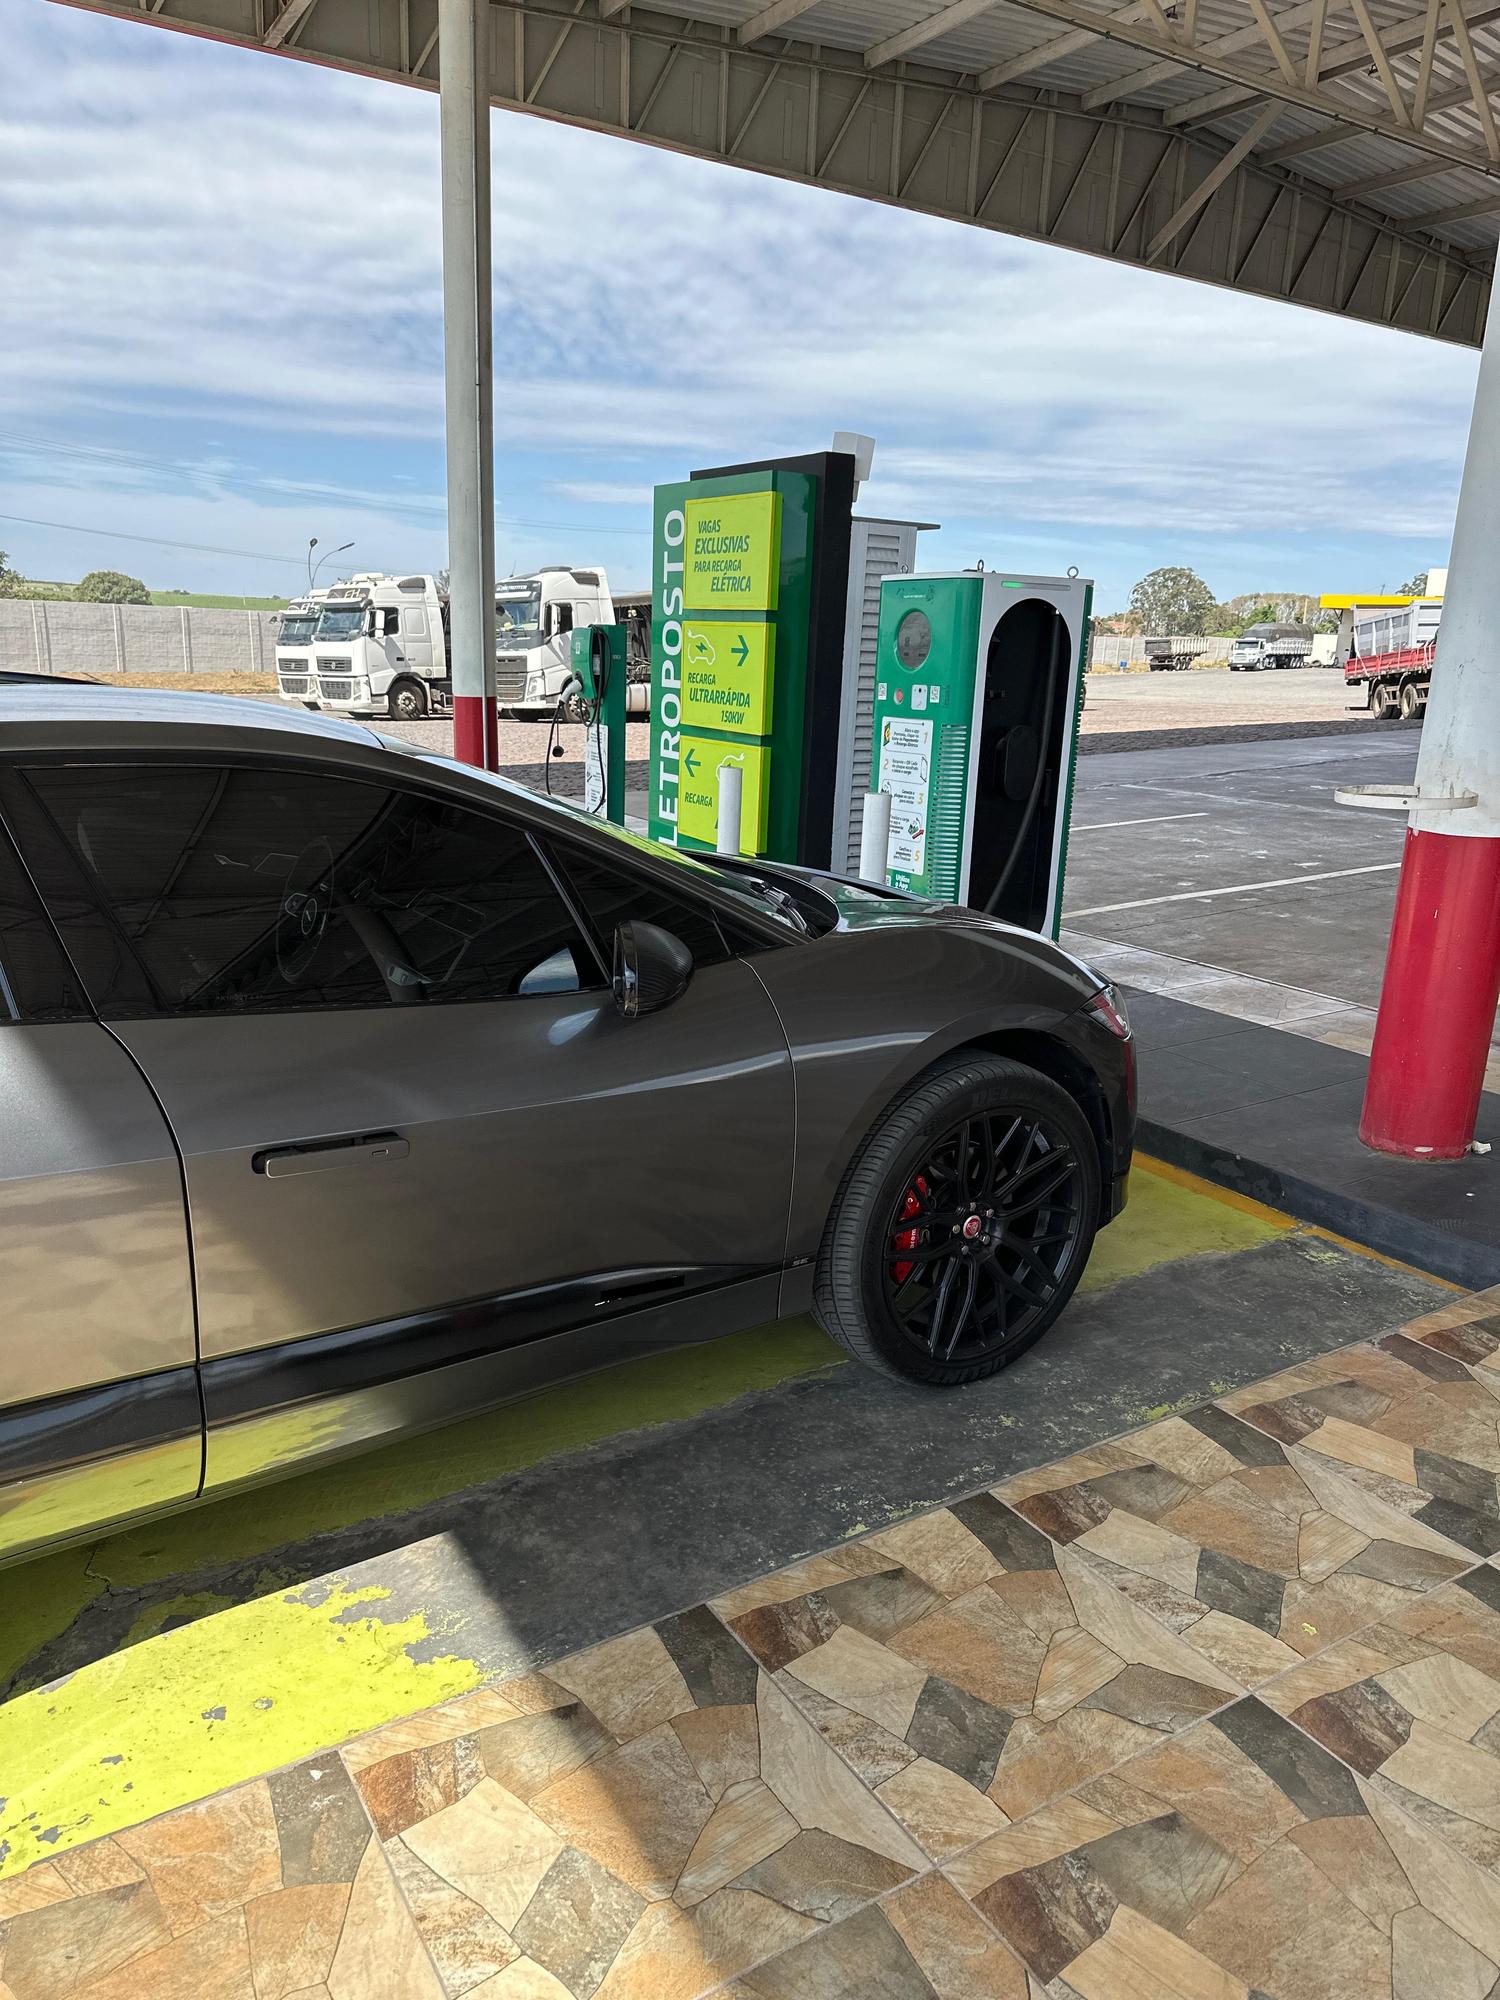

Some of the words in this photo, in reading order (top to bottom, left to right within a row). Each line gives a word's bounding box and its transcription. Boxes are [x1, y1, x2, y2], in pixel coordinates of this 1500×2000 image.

[698, 519, 721, 534] VAGAS
[694, 535, 750, 555] EXCLUSIVAS
[694, 560, 711, 572] PARA
[711, 559, 742, 572] RECARGA
[711, 572, 751, 592] ELÉTRICA
[658, 509, 685, 846] LETROPOSTO
[687, 672, 716, 685] RECARGA
[689, 687, 750, 708] ULTRARRÁPIDA
[721, 710, 745, 725] 150KW
[684, 792, 713, 808] RECARGA
